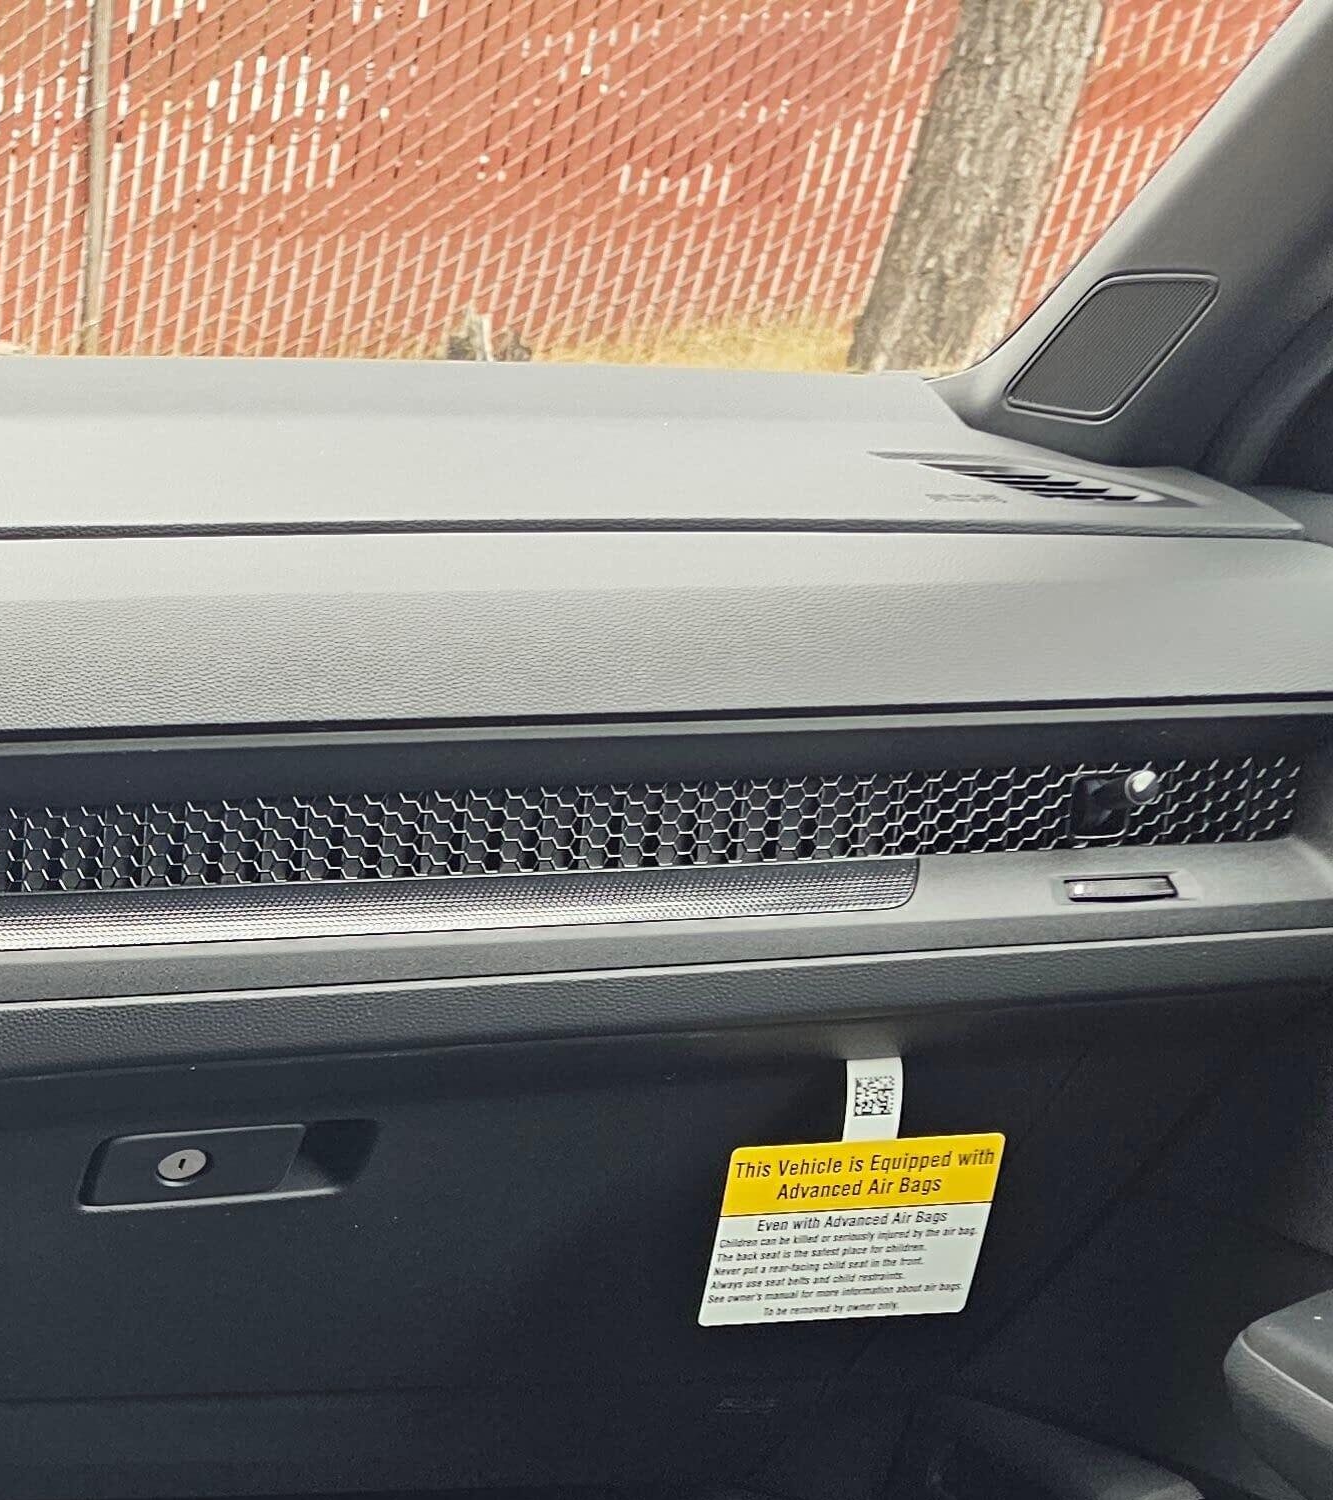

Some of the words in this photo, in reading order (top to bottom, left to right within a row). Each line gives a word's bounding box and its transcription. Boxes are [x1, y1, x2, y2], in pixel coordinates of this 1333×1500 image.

[735, 1161, 772, 1178] This
[778, 1157, 842, 1177] Vehicle
[848, 1156, 864, 1173] is
[870, 1150, 953, 1174] Equipped
[958, 1148, 995, 1167] with
[777, 1179, 863, 1200] Advanced
[867, 1178, 895, 1196] Air
[899, 1176, 943, 1196] Bags
[757, 1219, 789, 1232] Even
[792, 1216, 821, 1230] with
[824, 1212, 889, 1228] Advanced
[891, 1211, 913, 1225] Air
[915, 1210, 948, 1225] Bags
[720, 1237, 758, 1248] Children
[760, 1238, 777, 1246] can
[779, 1235, 790, 1245] be
[793, 1234, 819, 1244] killed
[877, 1229, 911, 1241] injured
[912, 1229, 924, 1239] by
[942, 1227, 956, 1236] air
[717, 1253, 733, 1262] The
[736, 1252, 757, 1261] back
[760, 1250, 780, 1260] seat
[782, 1250, 791, 1258] is
[794, 1249, 808, 1258] the
[811, 1247, 840, 1257] safest
[842, 1247, 867, 1257] place
[869, 1245, 884, 1254] for
[714, 1267, 741, 1276] Never
[743, 1266, 759, 1277] put
[822, 1260, 846, 1270] child
[848, 1260, 869, 1269] seat
[882, 1258, 897, 1267] the
[707, 1294, 726, 1303] See
[764, 1290, 799, 1300] manual
[800, 1289, 814, 1298] for
[815, 1289, 839, 1297] more
[841, 1286, 894, 1296] information
[895, 1284, 923, 1293] about
[924, 1283, 938, 1292] air
[710, 1280, 743, 1291] Always
[745, 1280, 763, 1289] use
[764, 1278, 785, 1287] seat
[813, 1275, 831, 1284] and
[763, 1307, 774, 1316] To
[776, 1307, 787, 1316] be
[790, 1305, 831, 1315] removed
[846, 1302, 876, 1312] owner
